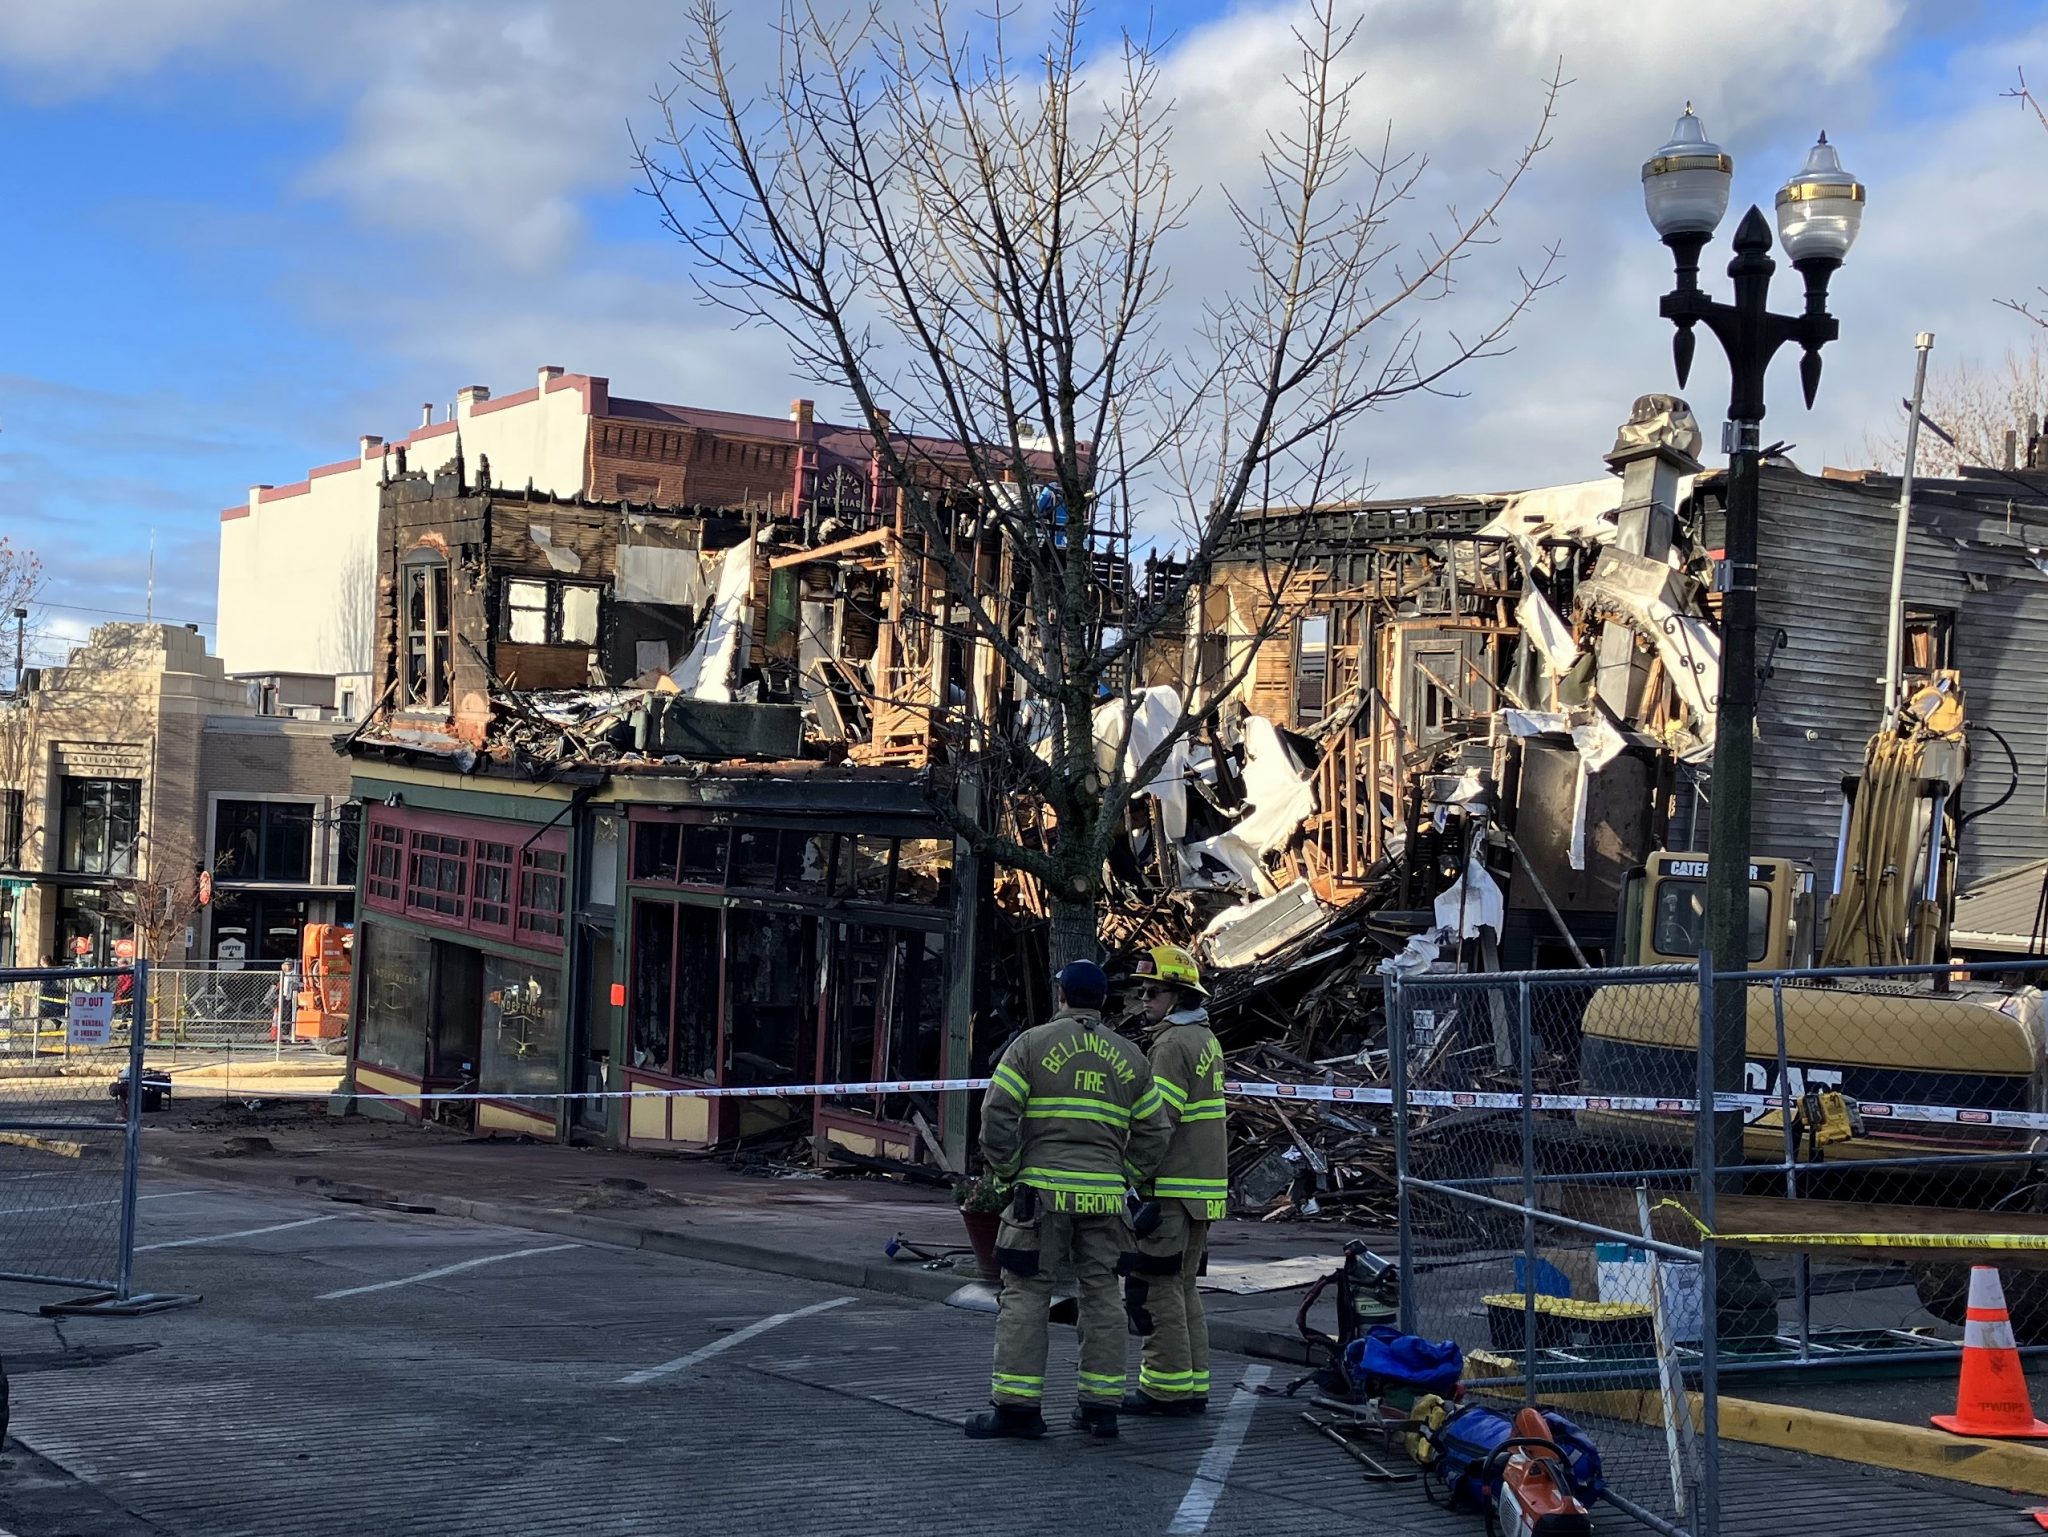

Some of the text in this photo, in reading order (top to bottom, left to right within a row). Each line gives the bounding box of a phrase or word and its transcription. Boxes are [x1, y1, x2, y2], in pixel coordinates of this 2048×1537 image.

[73, 755, 130, 765] BUILDING
[88, 996, 104, 1007] OUT
[1041, 1032, 1136, 1085] BELLINGHAM
[1074, 1070, 1107, 1093] FIRE
[1055, 1191, 1122, 1214] N. BROWN
